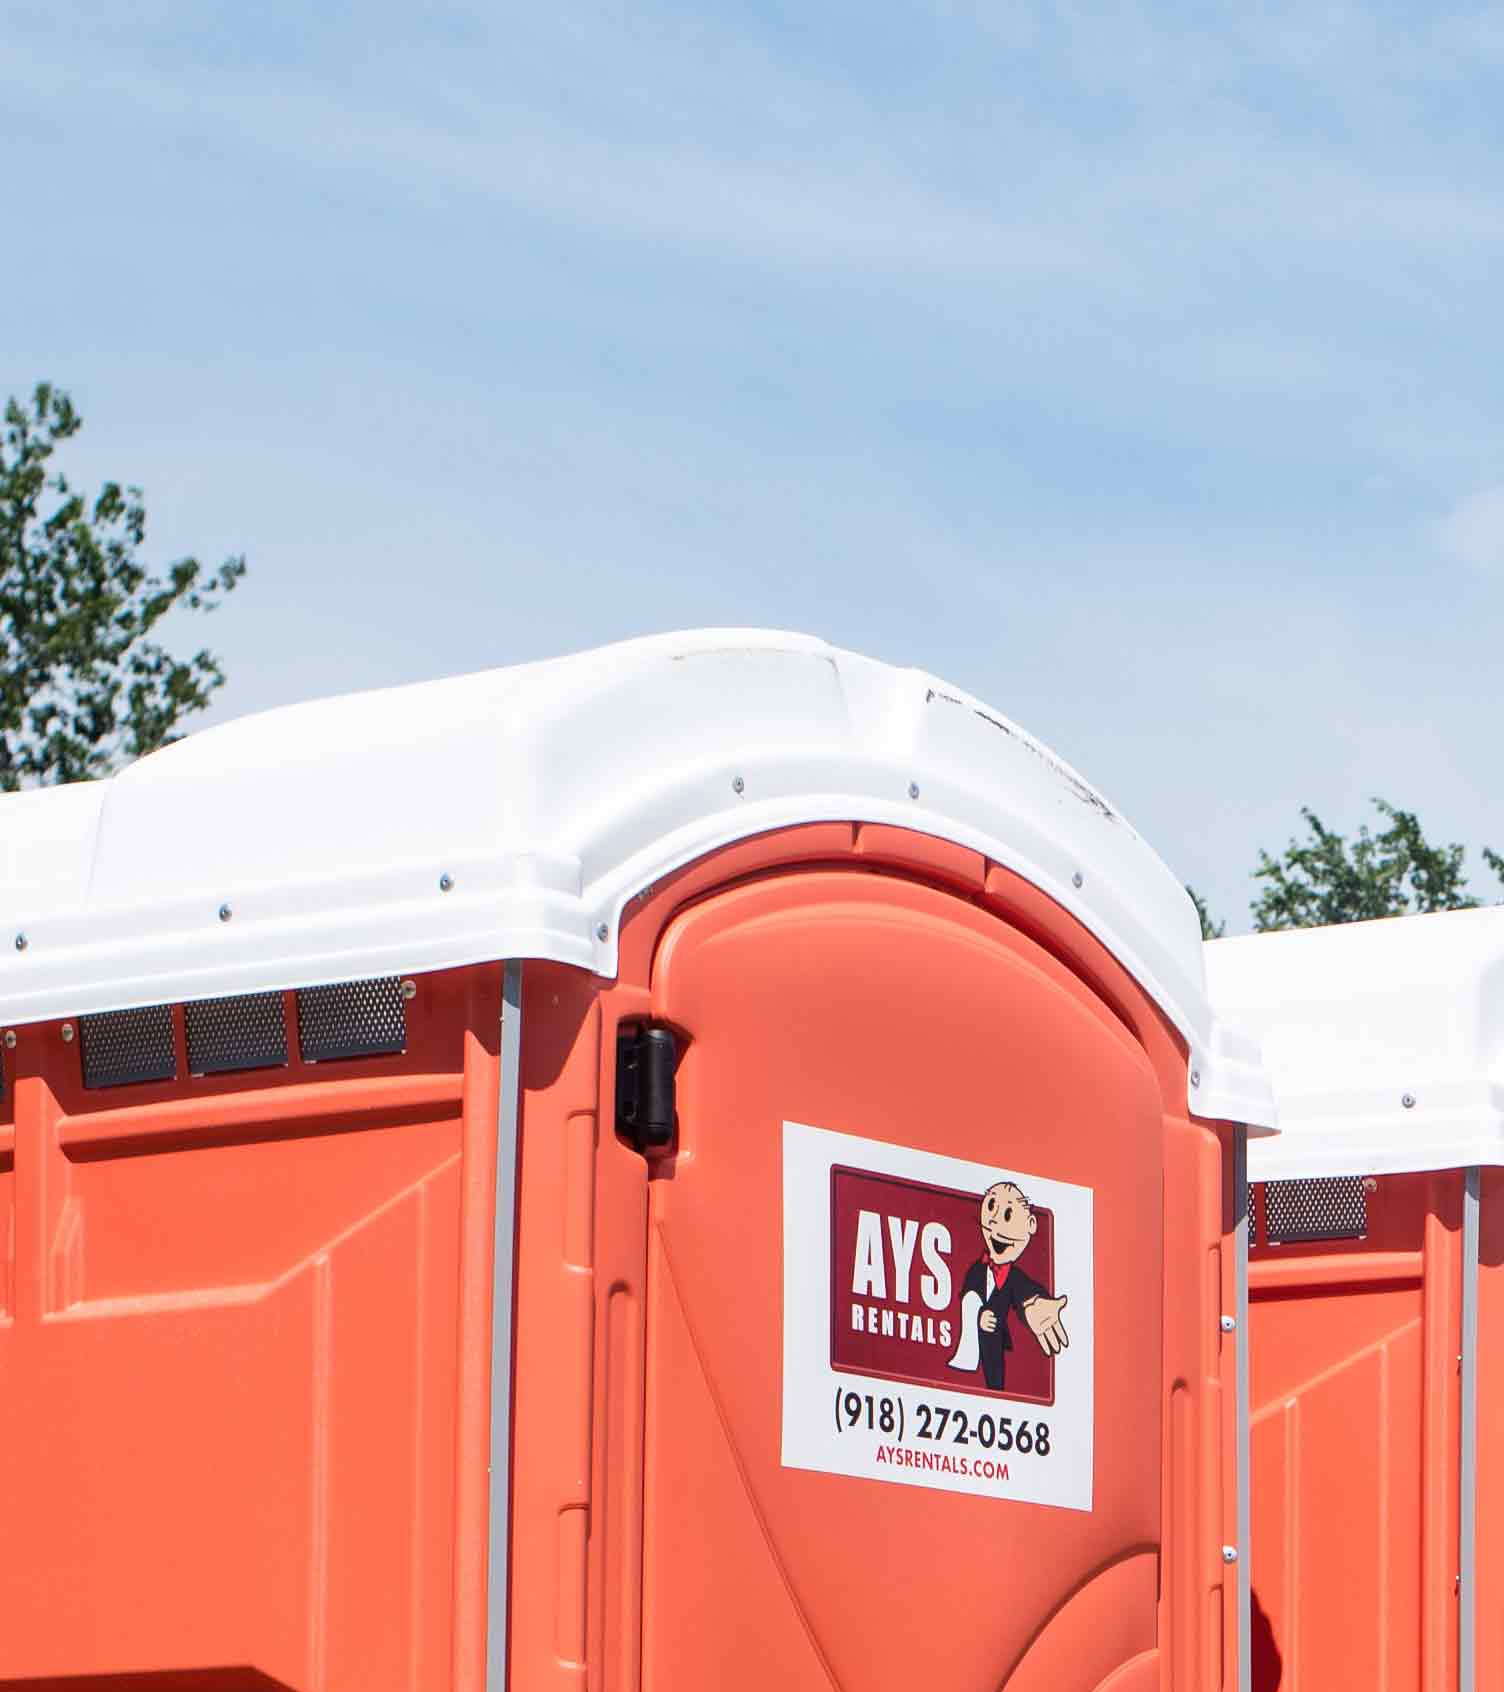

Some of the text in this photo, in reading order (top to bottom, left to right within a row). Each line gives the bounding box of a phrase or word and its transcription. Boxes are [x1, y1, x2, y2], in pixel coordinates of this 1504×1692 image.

[851, 1210, 952, 1311] AYS
[851, 1304, 952, 1348] RENTALS
[835, 1387, 1051, 1457] (918) 272-0568
[876, 1445, 1010, 1481] AYSRENTALS.COM
